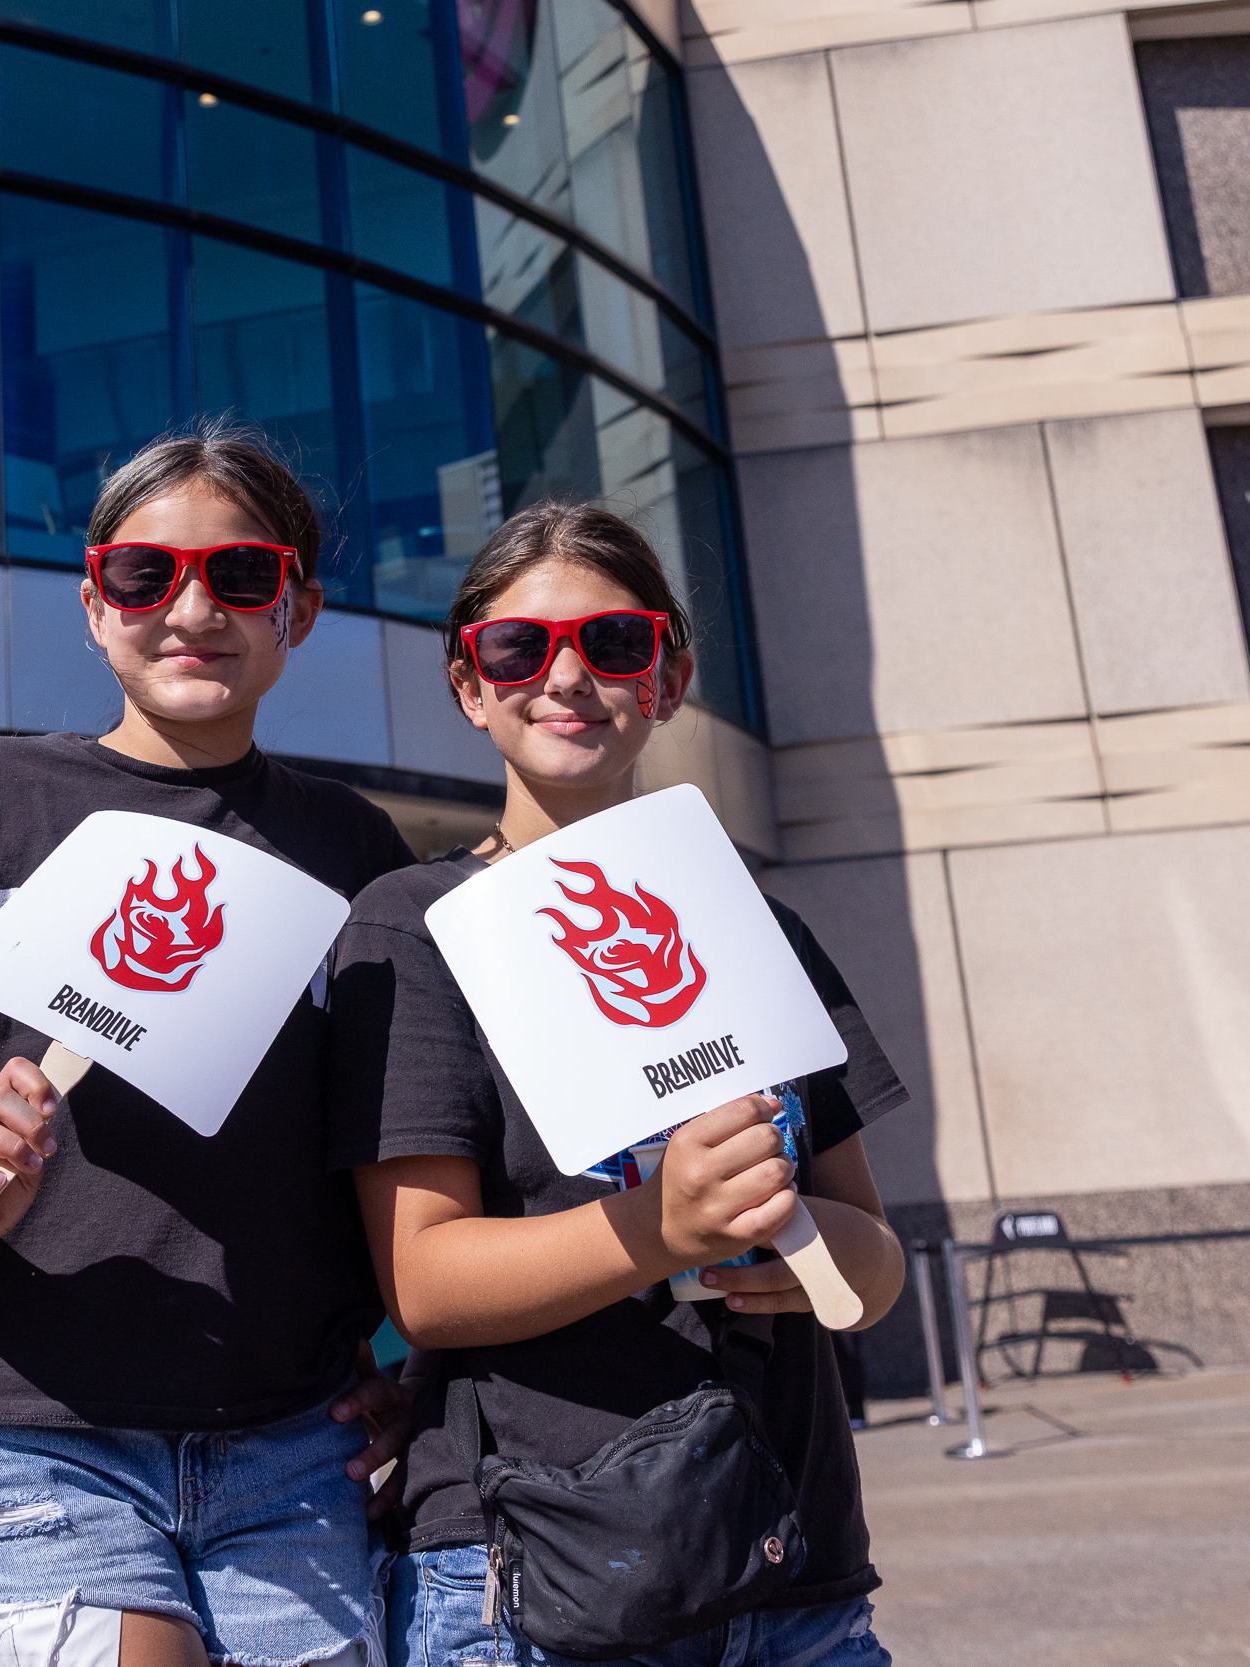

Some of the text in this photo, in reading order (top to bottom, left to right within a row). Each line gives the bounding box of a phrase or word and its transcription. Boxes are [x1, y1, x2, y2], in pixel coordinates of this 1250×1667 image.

[47, 984, 148, 1052] BRANDLIVE
[642, 1034, 745, 1099] BRANDLIVE
[512, 1567, 522, 1608] lulemon
